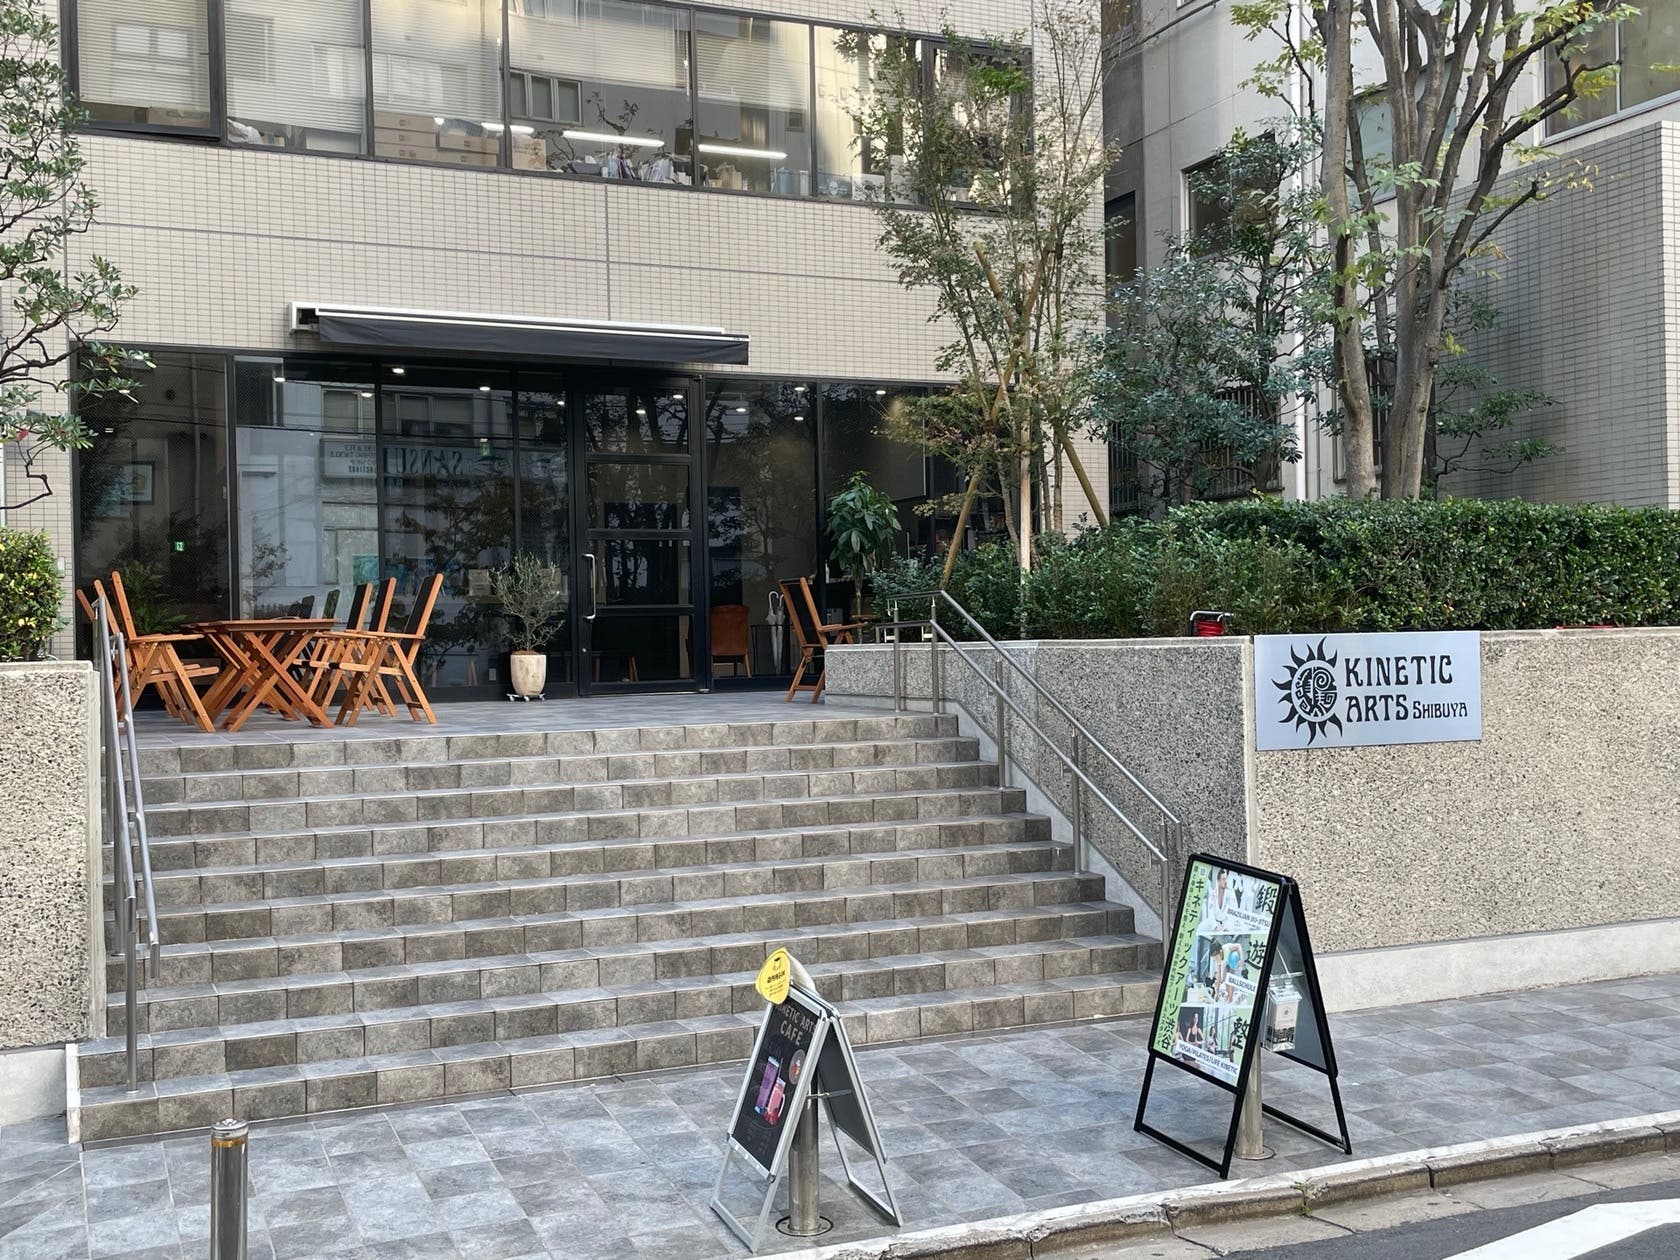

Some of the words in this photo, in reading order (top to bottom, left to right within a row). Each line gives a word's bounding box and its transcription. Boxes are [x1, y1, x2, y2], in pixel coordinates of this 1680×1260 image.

[1344, 655, 1453, 687] KINETIC
[1345, 694, 1409, 722] ARTS
[1412, 701, 1468, 720] SHIBUYA
[1227, 908, 1250, 921] BRAZILIAN
[1255, 884, 1278, 915] 鍛
[1161, 879, 1204, 1050] キネティックアーツ渋谷
[1244, 940, 1266, 970] 遊
[780, 1020, 804, 1046] CAFE
[1231, 1016, 1251, 1050] 整
